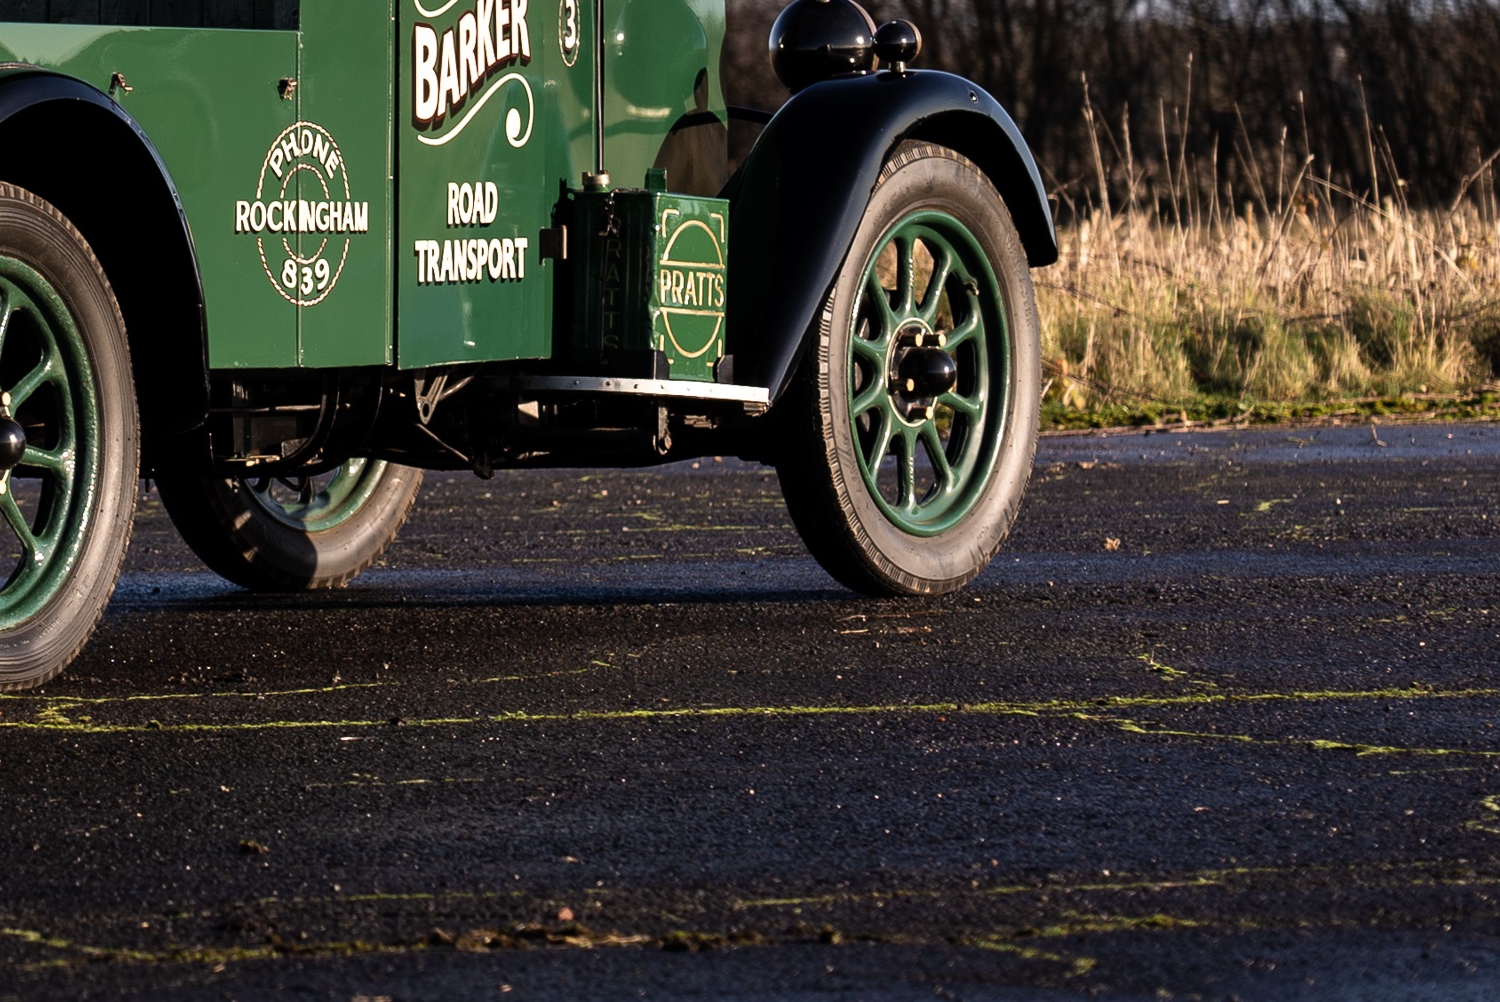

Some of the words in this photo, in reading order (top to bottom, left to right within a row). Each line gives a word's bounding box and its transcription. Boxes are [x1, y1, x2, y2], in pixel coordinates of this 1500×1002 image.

[268, 129, 340, 179] PHONE
[235, 200, 368, 233] ROCKINGHAM
[447, 181, 499, 227] ROAD
[281, 259, 331, 295] 839
[414, 237, 528, 284] TRANSPORT
[660, 269, 724, 307] PRATTS
